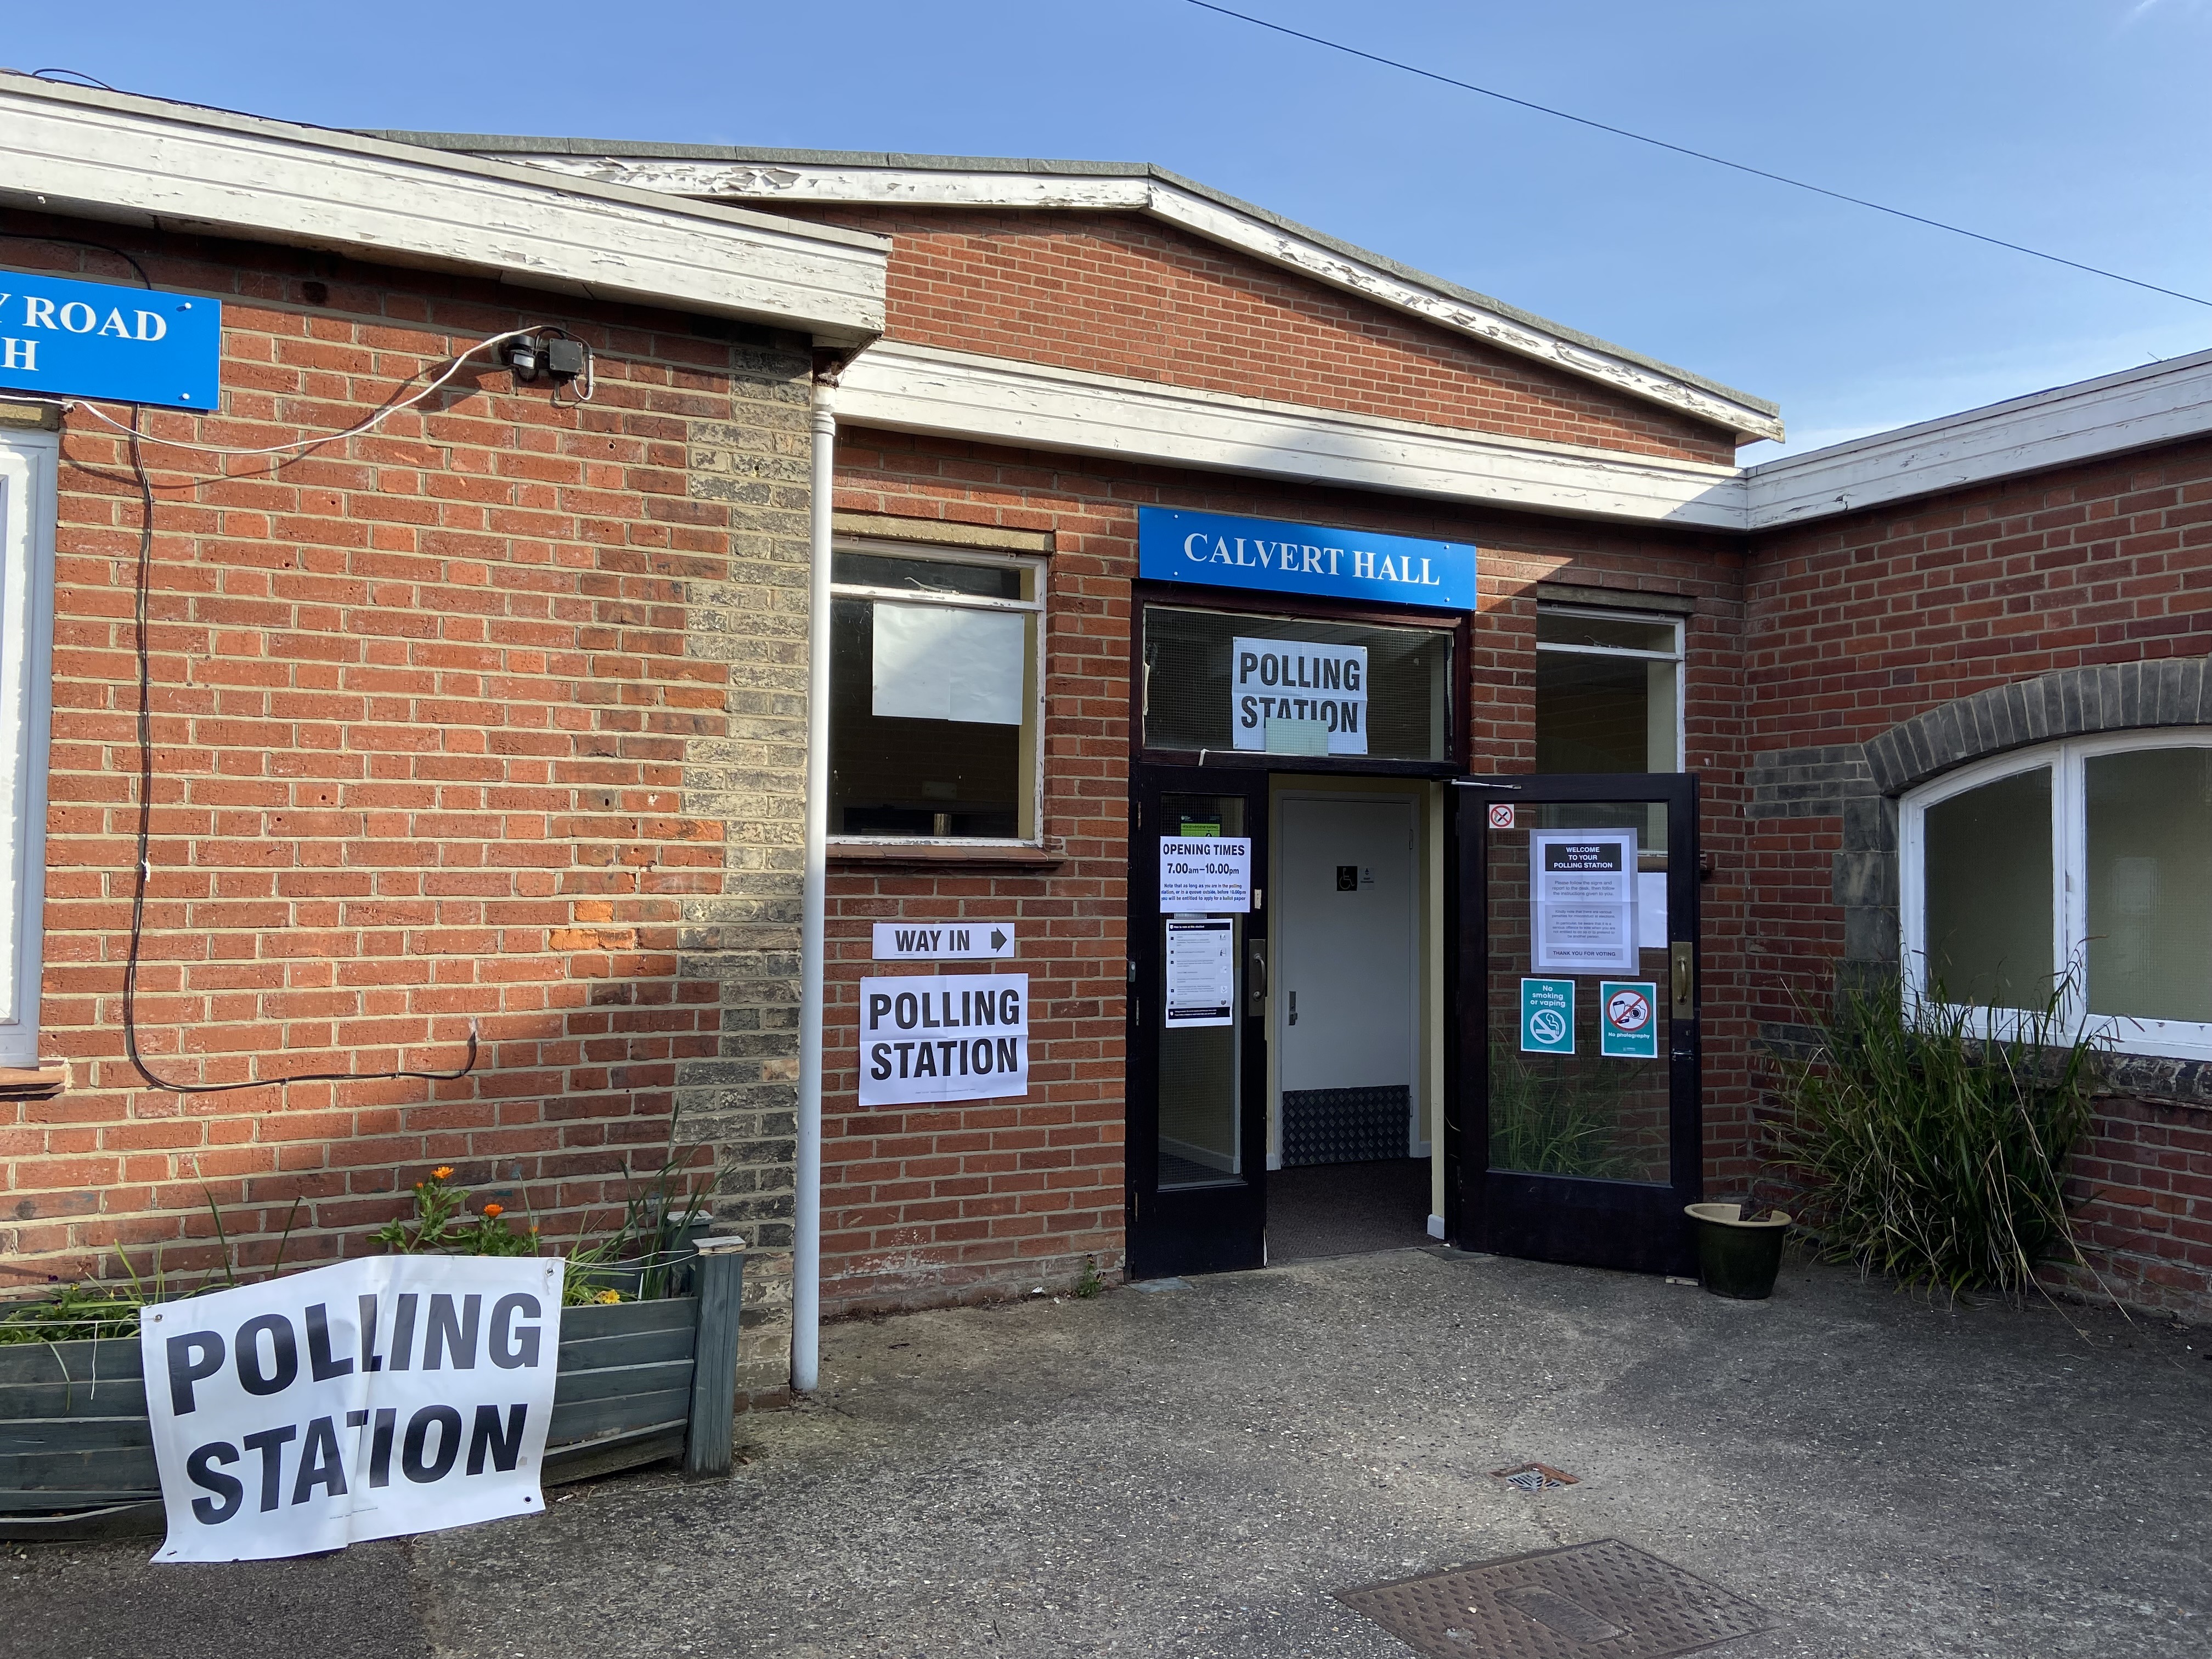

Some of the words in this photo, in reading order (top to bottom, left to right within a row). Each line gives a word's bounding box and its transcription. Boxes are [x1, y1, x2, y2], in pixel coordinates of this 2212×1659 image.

[22, 295, 167, 341] ROAD
[1184, 533, 1344, 575] CALVERT
[1352, 550, 1440, 586] HALL
[1240, 652, 1360, 691] POLLING
[1163, 844, 1210, 855] OPENING
[1214, 844, 1245, 855] TIMES
[894, 930, 942, 951] WAY
[949, 930, 970, 951] IN
[869, 989, 1019, 1030] POLLING
[871, 1037, 1017, 1081] STATION
[166, 1293, 542, 1417] POLLING
